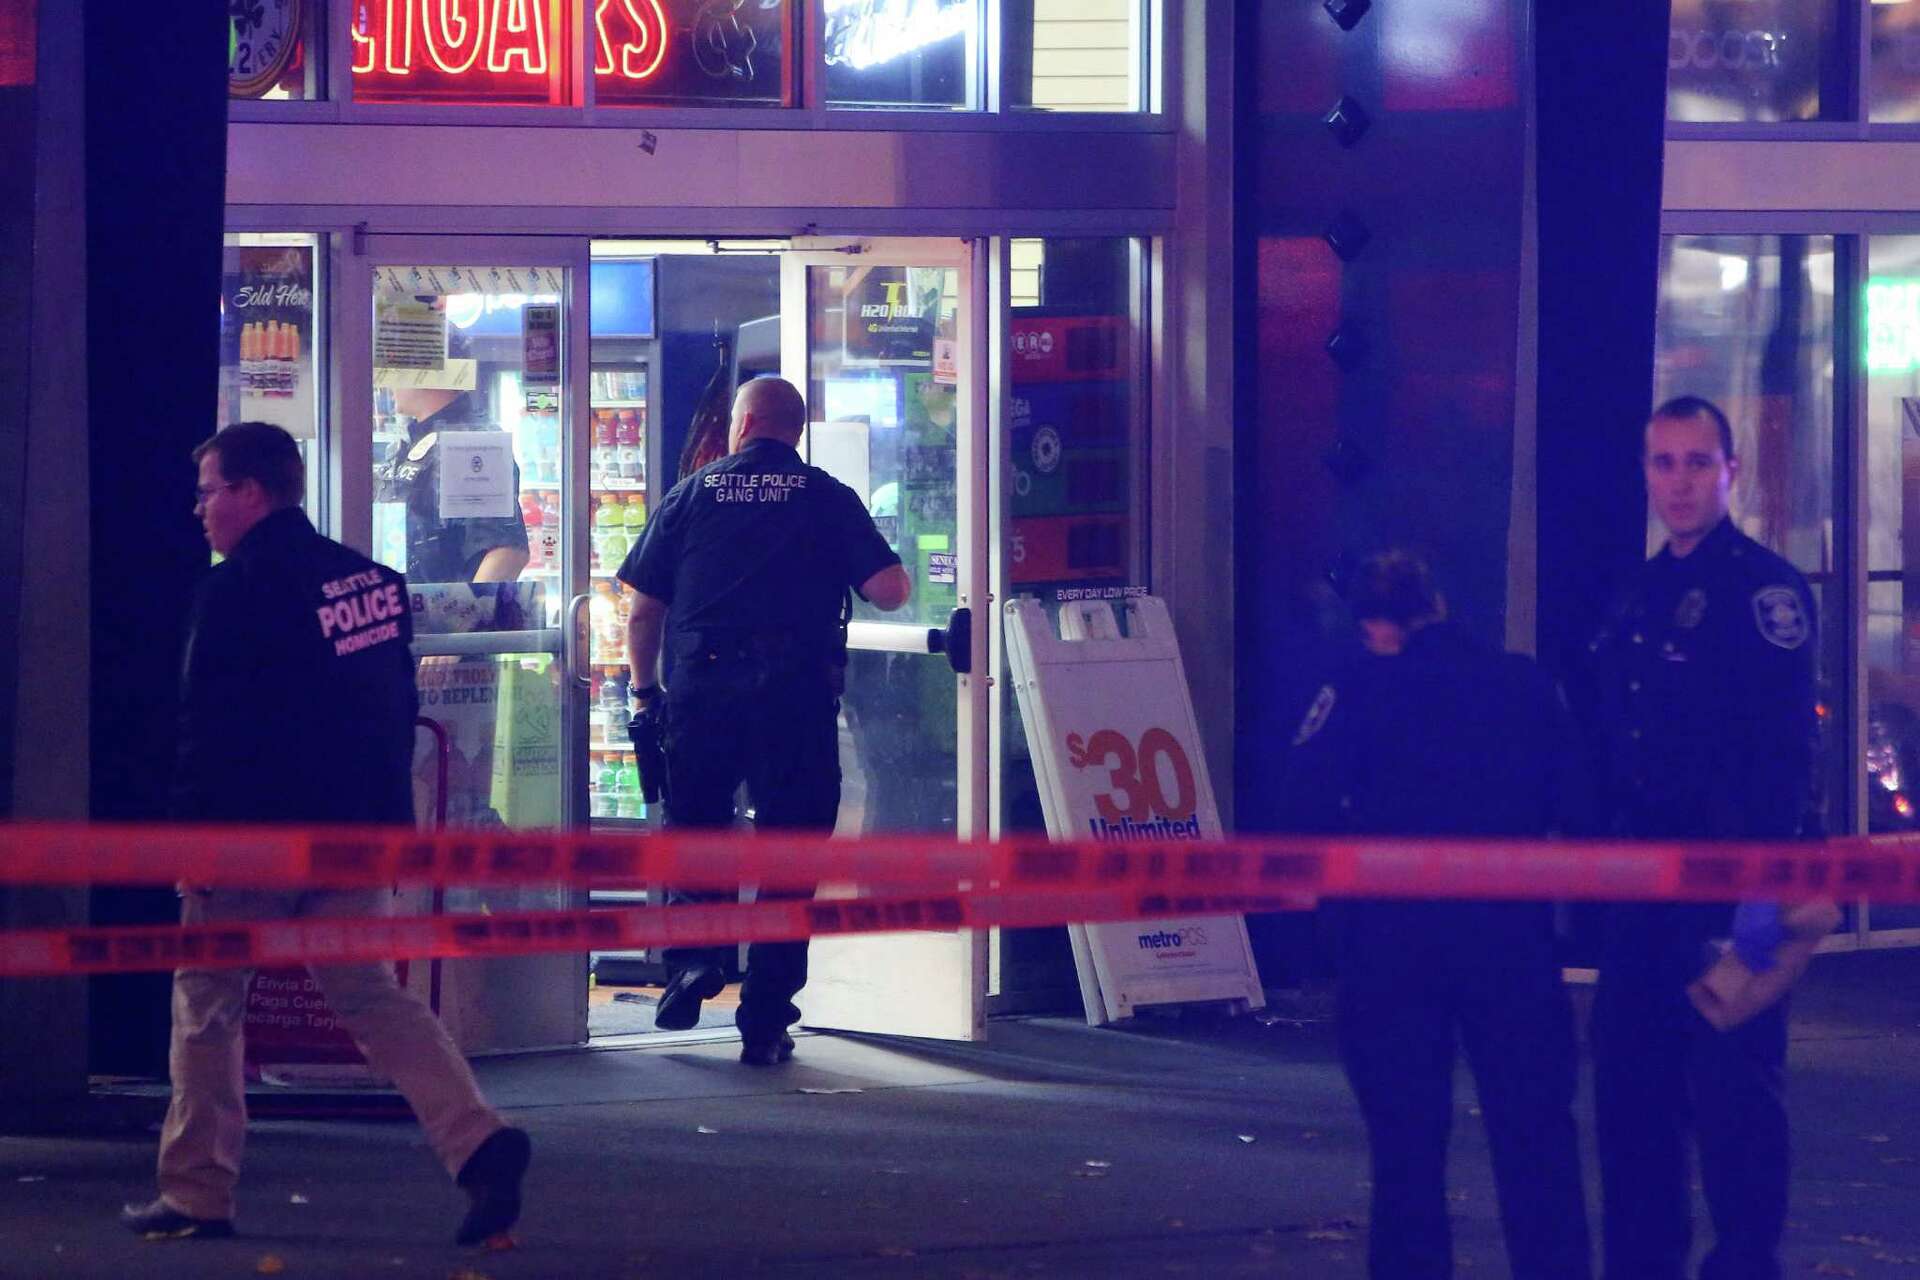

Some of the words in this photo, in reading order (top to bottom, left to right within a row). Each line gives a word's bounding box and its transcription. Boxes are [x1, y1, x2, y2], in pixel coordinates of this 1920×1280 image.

[232, 284, 272, 309] Sold
[703, 473, 760, 488] SEATTLE
[761, 474, 807, 488] POLICE
[716, 488, 754, 502] GANG
[759, 487, 791, 502] UNIT
[322, 568, 382, 599] SEATTLE
[1056, 588, 1084, 601] EVERY
[1084, 587, 1103, 600] DAY
[1103, 586, 1124, 599] LOW
[317, 584, 404, 638] POLICE
[1066, 728, 1197, 825] $30
[1088, 814, 1202, 842] Unlimited
[1138, 927, 1209, 951] metroPCS
[246, 1013, 302, 1030] ecarga
